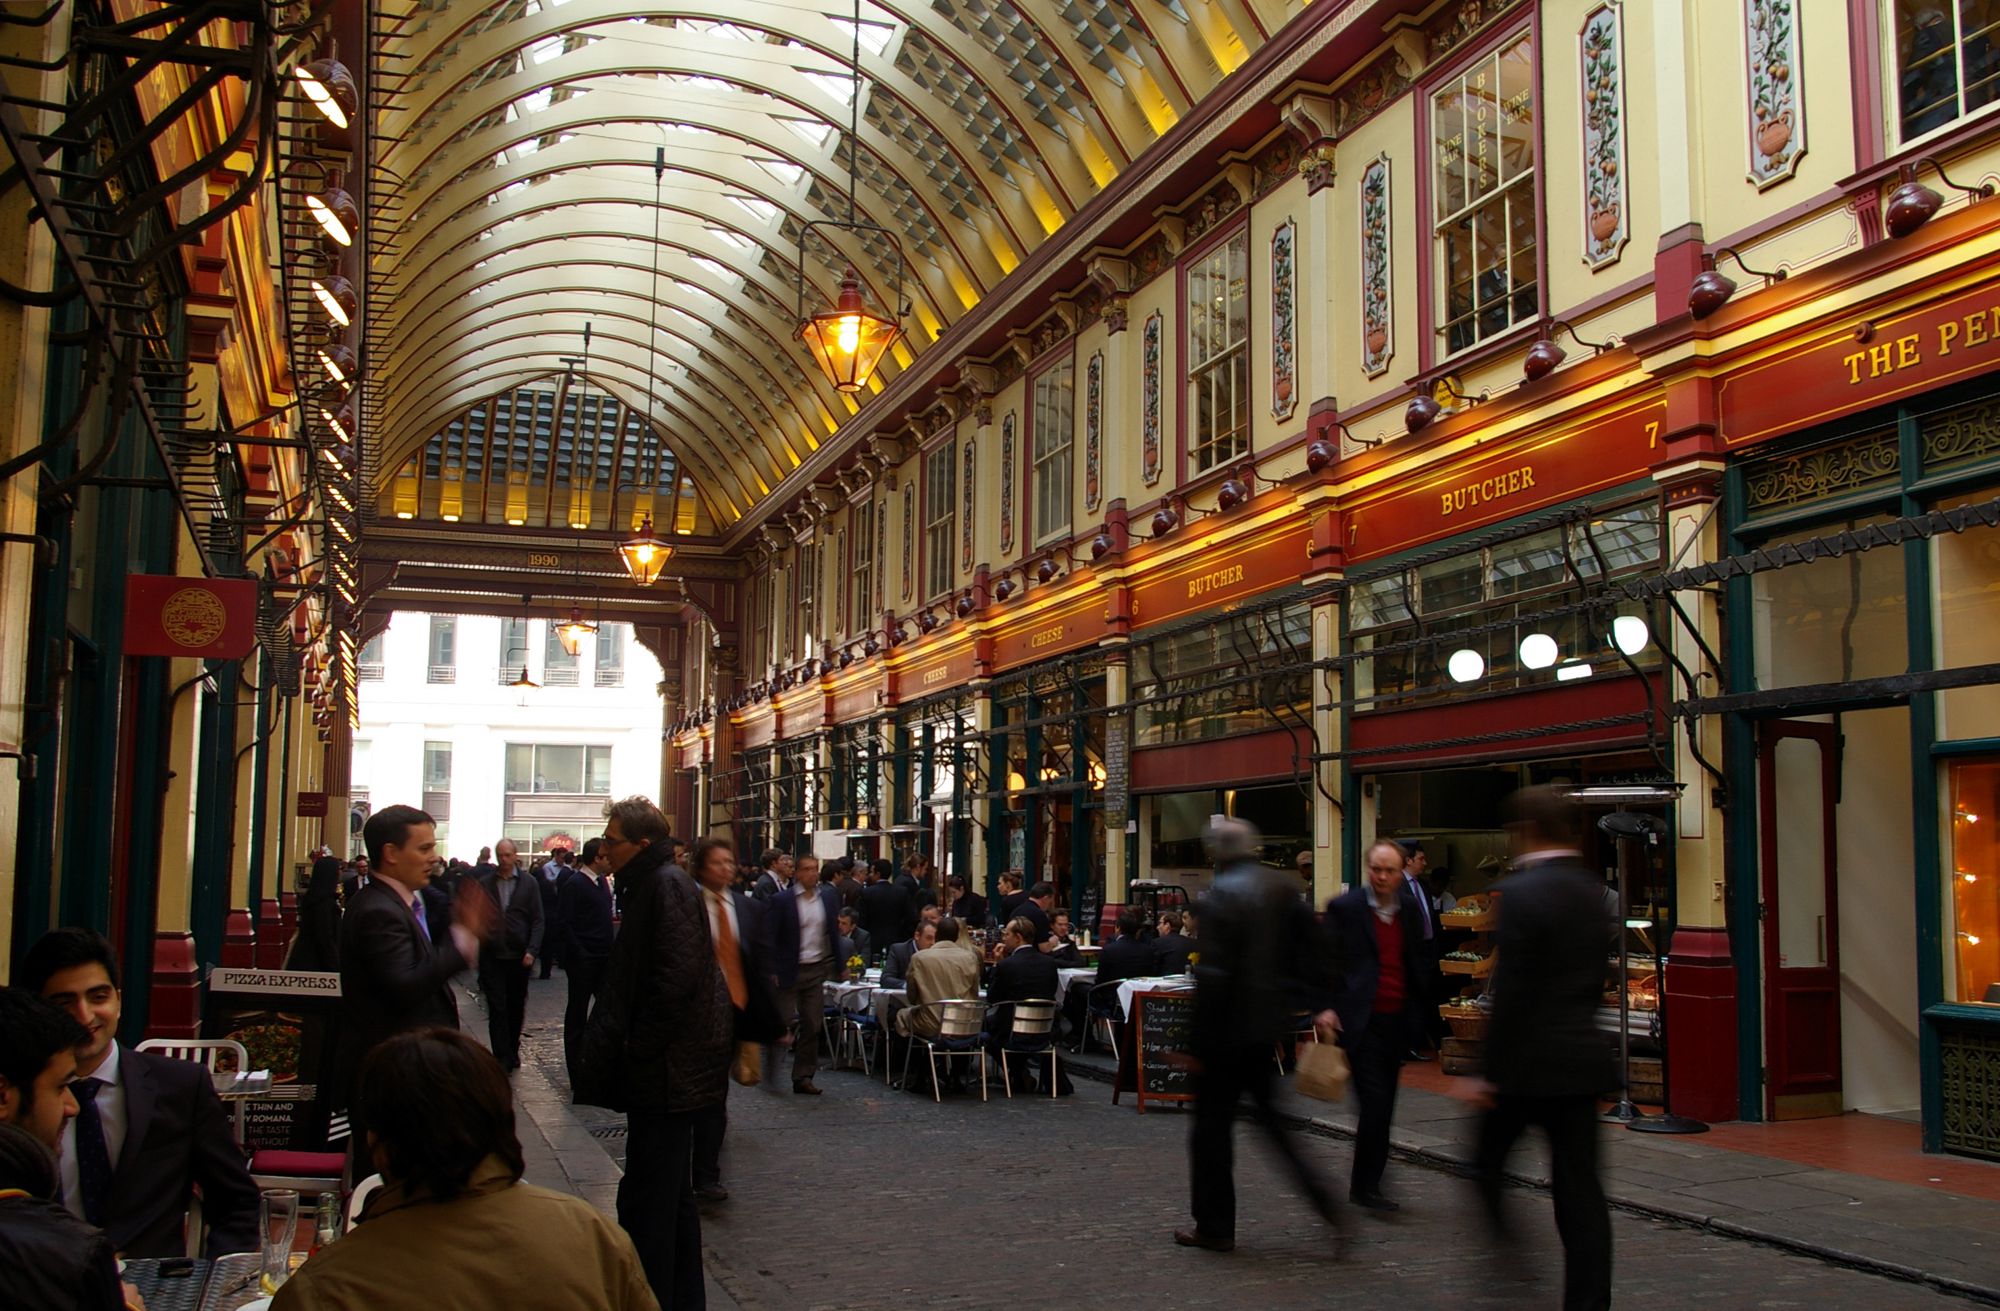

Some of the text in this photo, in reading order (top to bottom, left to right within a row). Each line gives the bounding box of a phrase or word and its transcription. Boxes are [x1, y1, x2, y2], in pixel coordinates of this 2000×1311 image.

[1503, 88, 1529, 112] WINE
[1506, 105, 1526, 126] BAR
[1477, 72, 1487, 189] BROKERS
[1439, 133, 1462, 154] WINE
[1441, 148, 1459, 168] BAR
[1843, 333, 1921, 384] THE
[1645, 421, 1659, 449] 7
[1441, 466, 1536, 515] BUTCHER
[1349, 524, 1358, 546] 7
[530, 554, 559, 566] 1990
[1187, 564, 1244, 598] BUTCHER
[1132, 600, 1139, 615] 6
[1031, 625, 1064, 648] CHEESE
[224, 973, 337, 989] PIZZA EXPRESS
[252, 1103, 273, 1111] THIN
[274, 1103, 295, 1111] AND
[264, 1126, 290, 1134] TASTE
